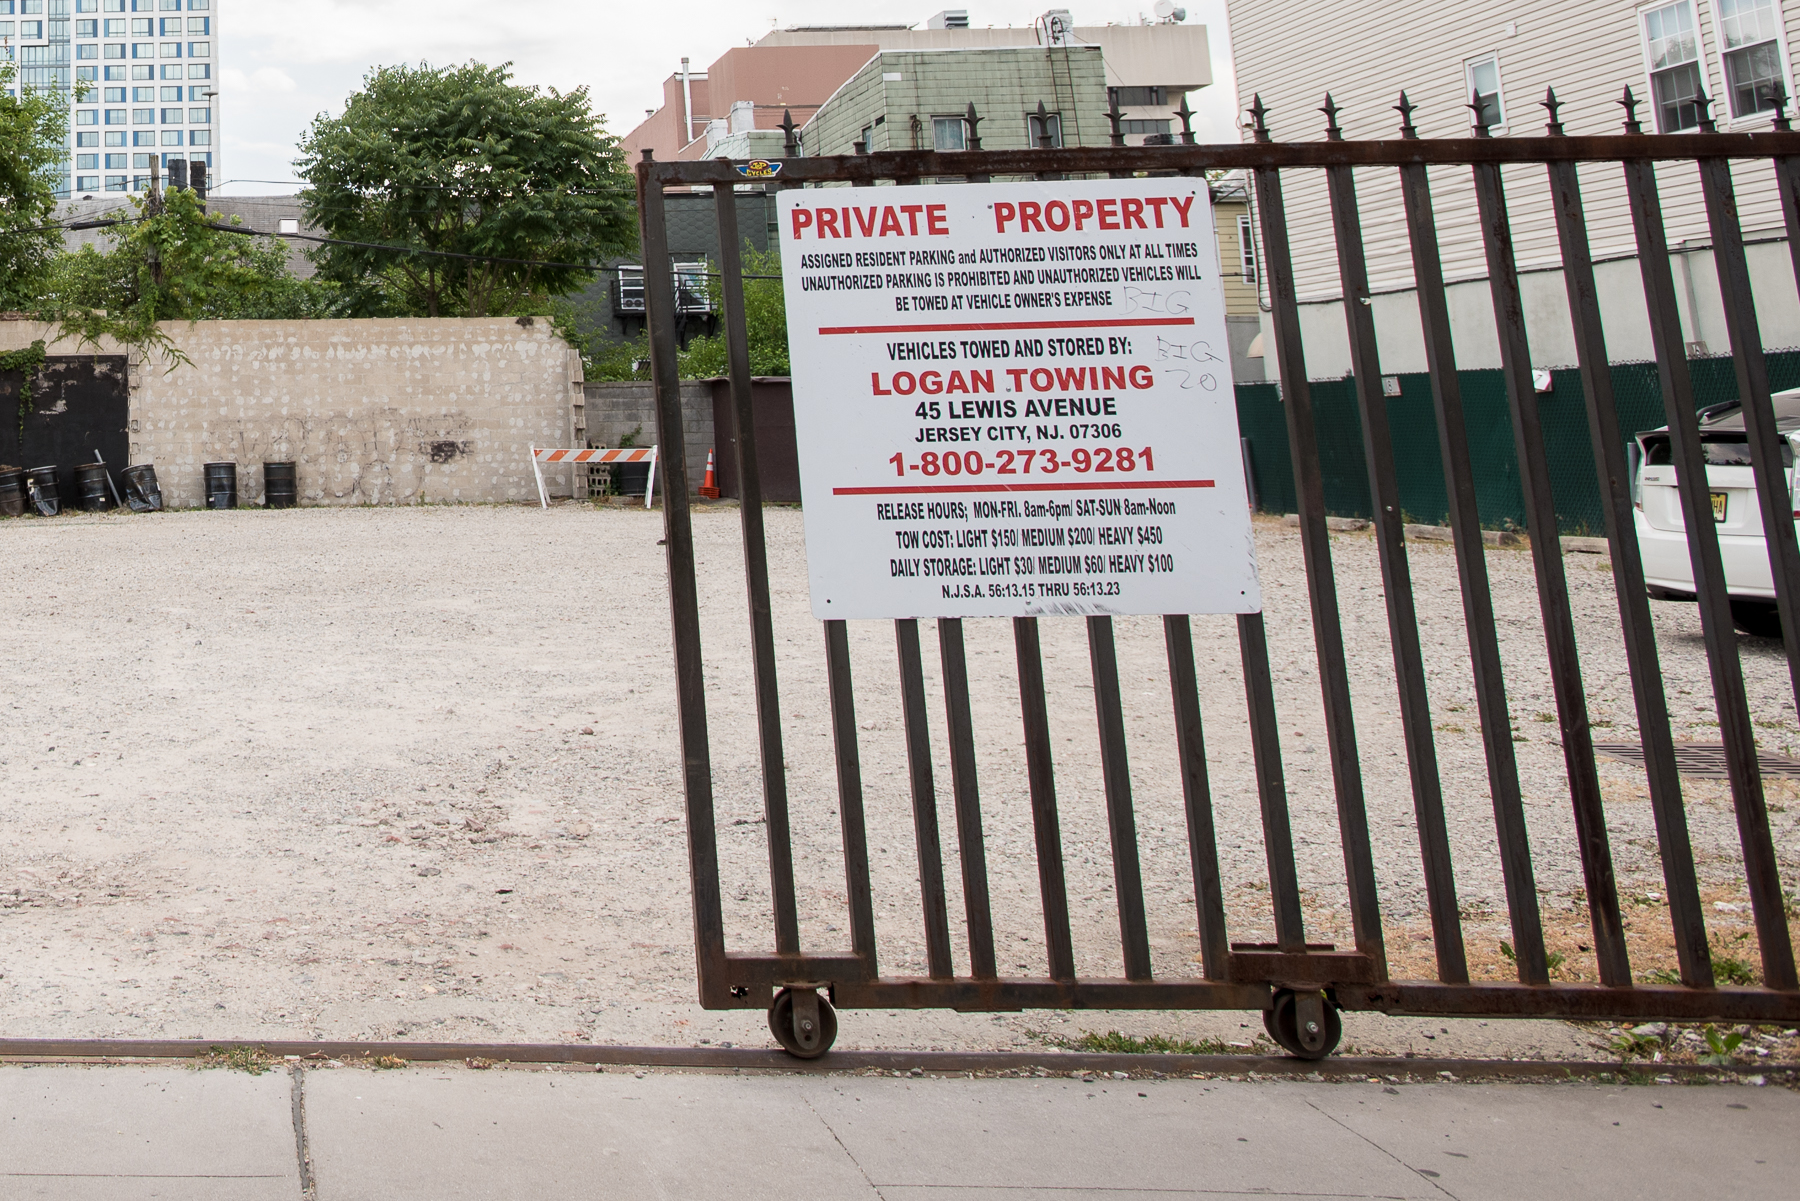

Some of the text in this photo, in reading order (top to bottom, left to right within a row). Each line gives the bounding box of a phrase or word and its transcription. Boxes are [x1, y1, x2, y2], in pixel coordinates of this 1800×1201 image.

[791, 196, 1194, 240] PRIVATE PROPERTY
[801, 242, 1198, 269] ASSIGNED RESIDENT PARKING and AUTHORIZED VISITORS ONLY AT ALL TIMES
[802, 265, 1201, 291] UNAUTHORIZED PARKING IS PROHIBITED AND UNAUTHORIZED VEHICLES WILL
[895, 291, 1112, 311] BE TOWED AT VEHICLE OWNER'S EXPENSE
[1119, 286, 1191, 315] BIG
[887, 337, 1132, 360] VEHICLES TOWED AND STORED BY:
[871, 365, 1154, 396] LOGAN TOWING
[915, 397, 1117, 420] 45 LEWIS AVENUE
[915, 423, 1122, 443] JERSEY CITY, NJ. 07306
[889, 446, 1154, 477] 1-800-273-9281
[877, 503, 925, 520] RELEASE
[927, 502, 968, 522] HOURS;
[973, 501, 1021, 518] MON-FRI.
[1076, 499, 1121, 516] SAT-SUN
[1124, 498, 1176, 515] 8am-Noon
[896, 531, 919, 548] TOW
[922, 530, 953, 548] COST:
[956, 530, 988, 548] LIGHT
[1022, 528, 1065, 546] MEDIUM
[1098, 527, 1133, 545] HEAVY
[1137, 526, 1163, 547] $450
[890, 559, 920, 577] DAILY
[923, 558, 976, 576] STORAGE:
[979, 557, 1010, 575] LIGHT
[1038, 556, 1081, 574] MEDIUM
[1109, 555, 1144, 573] HEAVY
[1148, 554, 1173, 575] $100
[942, 582, 1120, 598] N.J.S.A. 56:13.15 THRU 56:13.23
